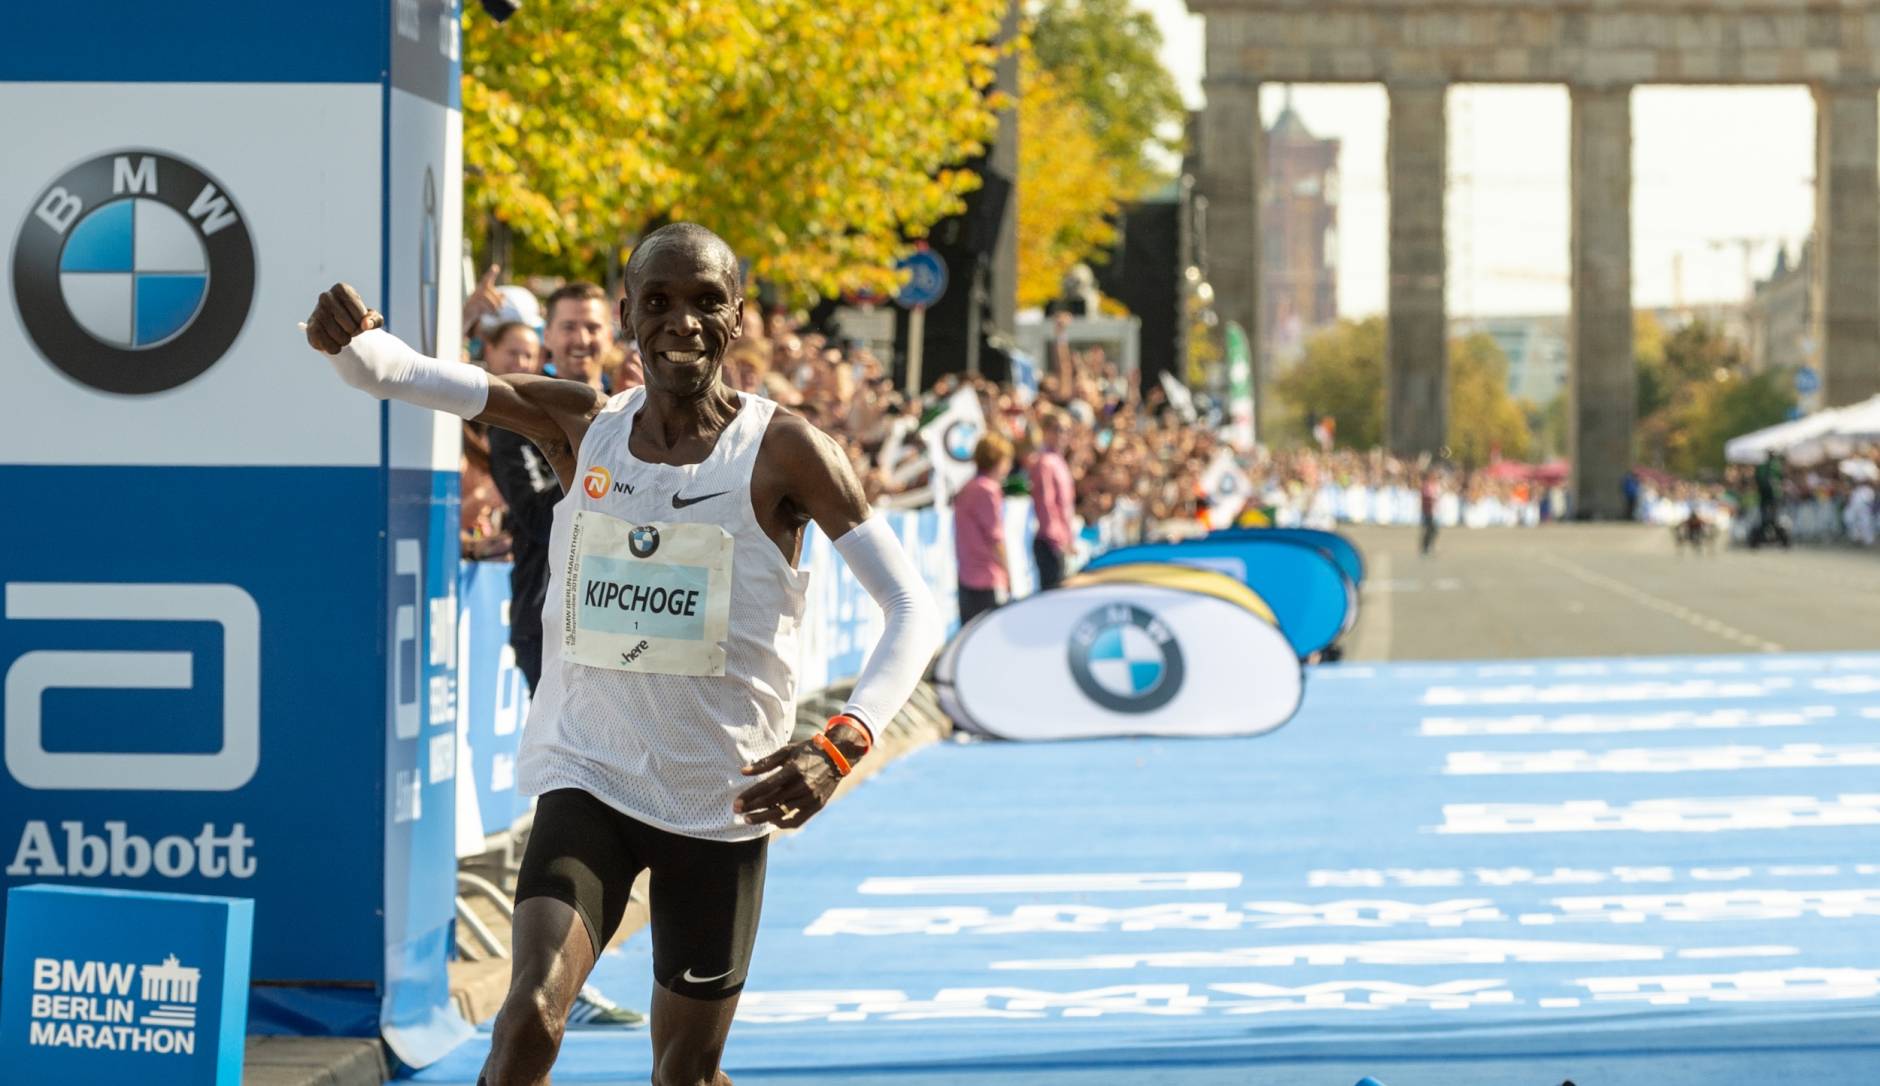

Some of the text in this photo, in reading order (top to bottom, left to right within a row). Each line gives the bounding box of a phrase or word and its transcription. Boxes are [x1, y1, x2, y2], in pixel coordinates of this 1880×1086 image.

[35, 156, 239, 236] BMW
[613, 481, 635, 495] NN
[584, 579, 699, 617] KIPCHOGE
[634, 621, 639, 630] 1
[621, 639, 649, 664] here
[6, 820, 258, 879] Abbott
[33, 957, 136, 996] BMW
[31, 993, 135, 1024] BERLIN
[29, 1020, 196, 1055] MARATHON
